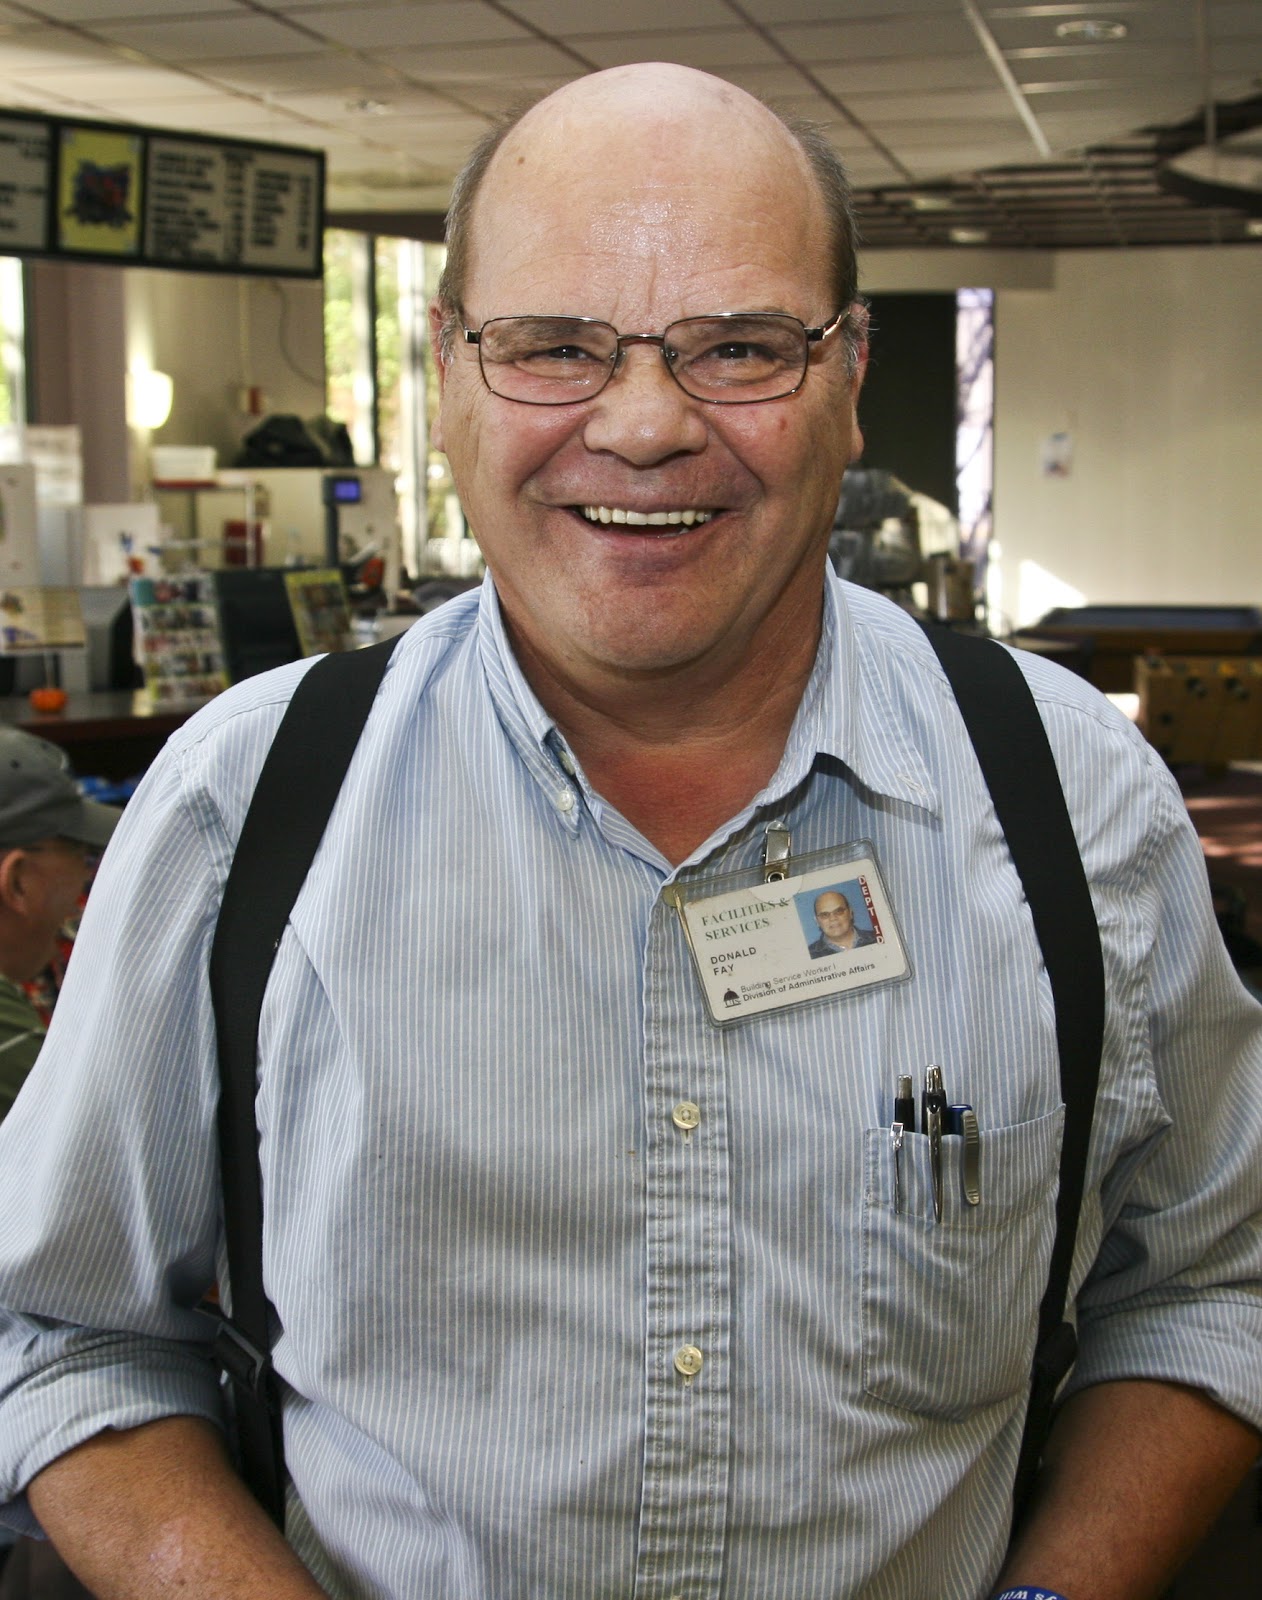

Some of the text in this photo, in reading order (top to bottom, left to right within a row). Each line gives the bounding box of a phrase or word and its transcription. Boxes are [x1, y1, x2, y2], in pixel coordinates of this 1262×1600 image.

[702, 898, 789, 927] FACILITIES &
[858, 876, 885, 945] DEPT ID
[705, 918, 770, 941] SERVICES
[711, 947, 757, 965] DONALD
[713, 964, 734, 976] FAY
[741, 979, 771, 993] Building
[773, 972, 801, 985] Service
[803, 965, 832, 979] Worker
[743, 962, 875, 1002] Division of Administrative Affairs
